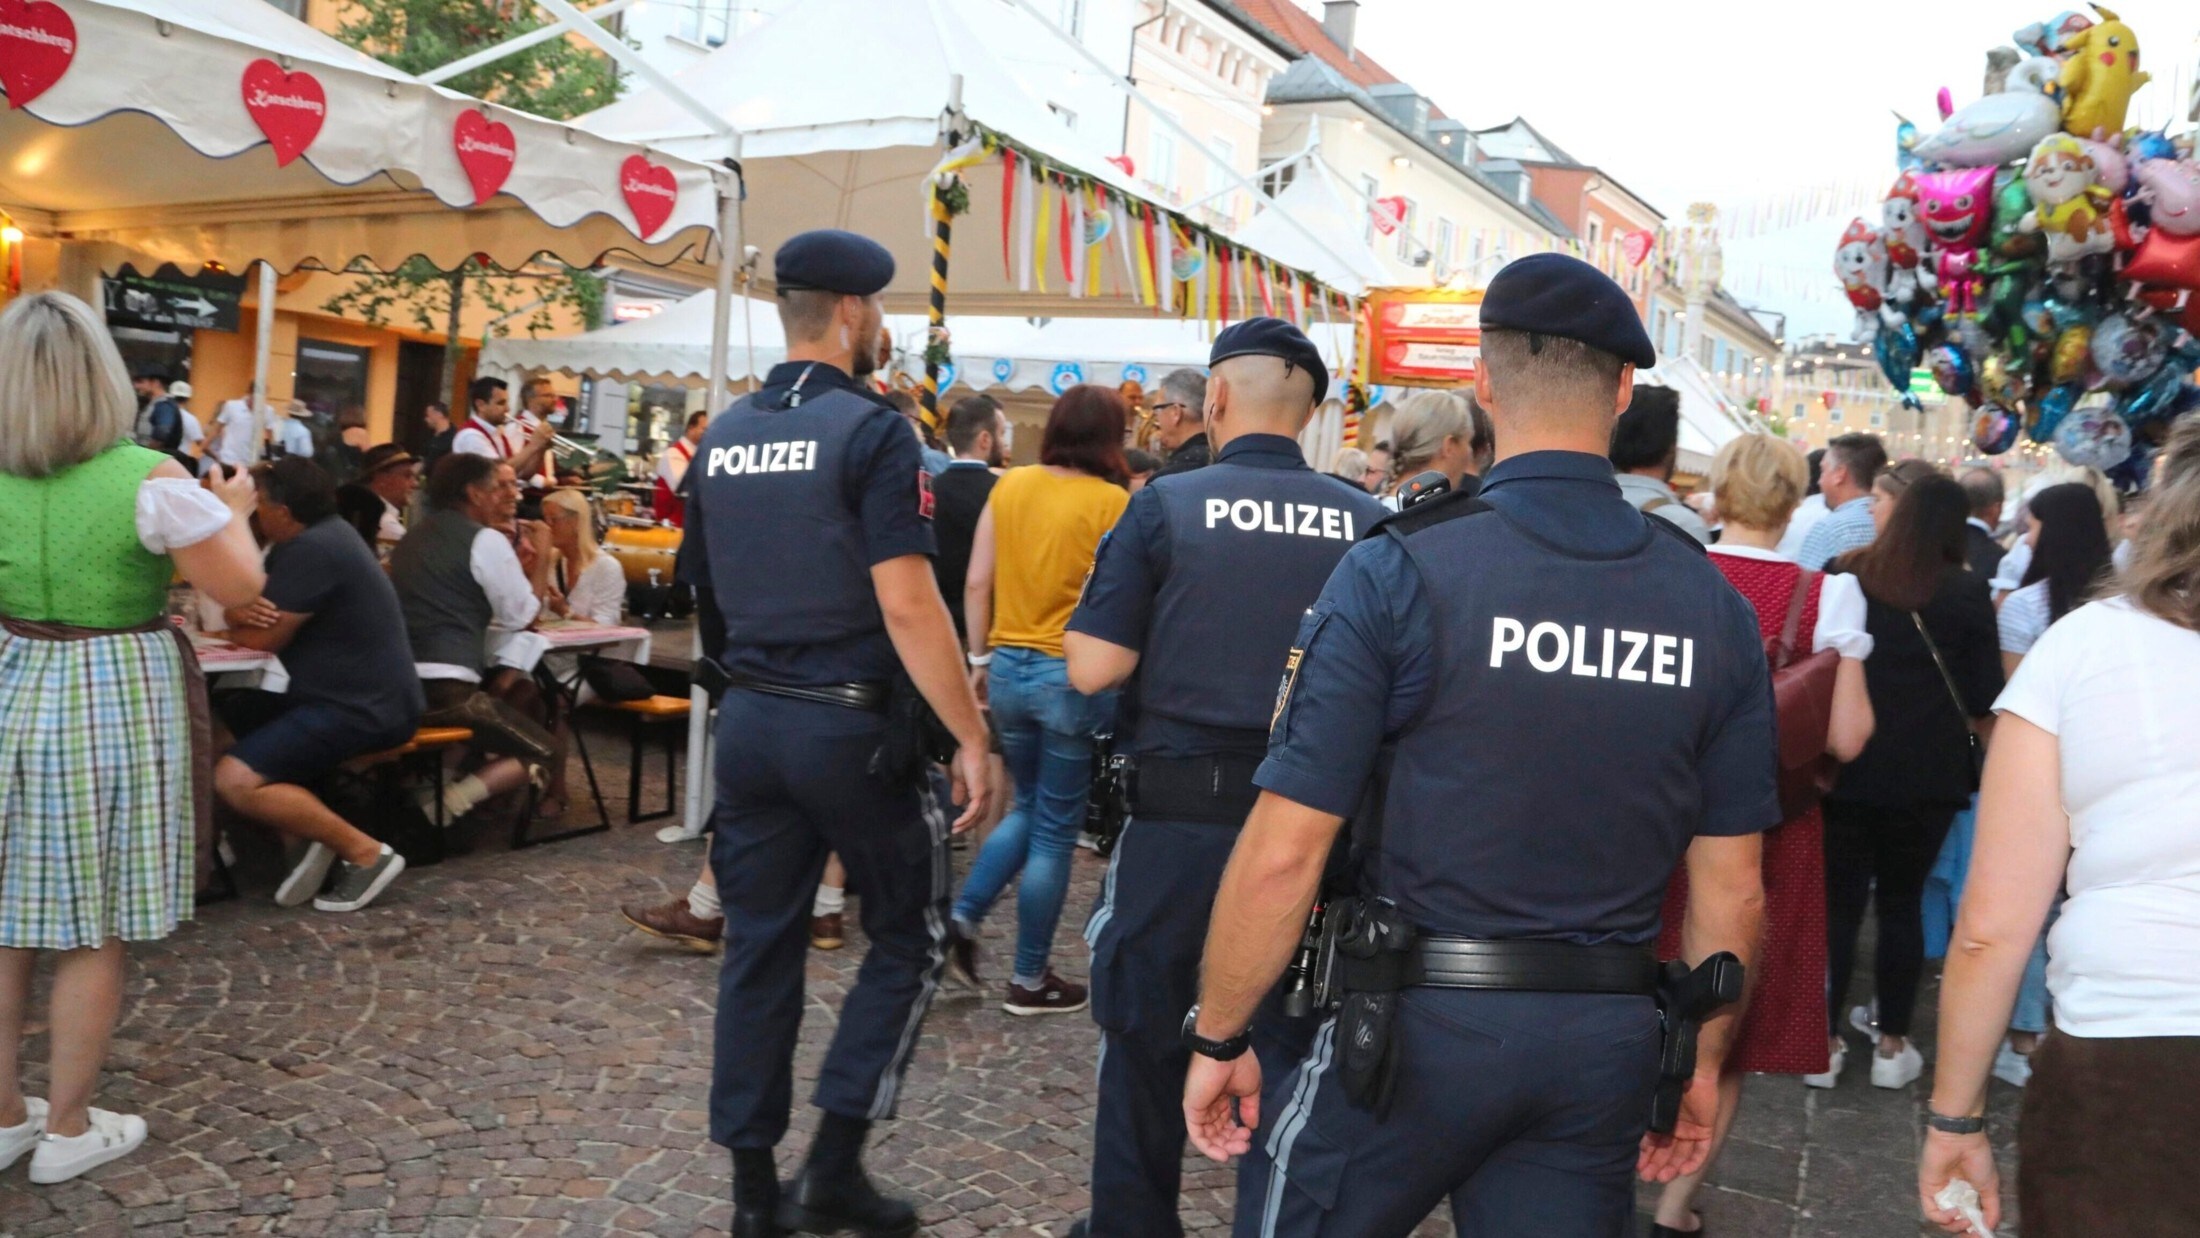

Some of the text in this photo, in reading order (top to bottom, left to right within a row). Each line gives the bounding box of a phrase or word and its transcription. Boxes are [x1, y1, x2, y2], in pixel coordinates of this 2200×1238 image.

[707, 440, 817, 477] POLIZEI
[1205, 498, 1354, 541] POLIZEI
[1489, 616, 1694, 688] POLIZEI
